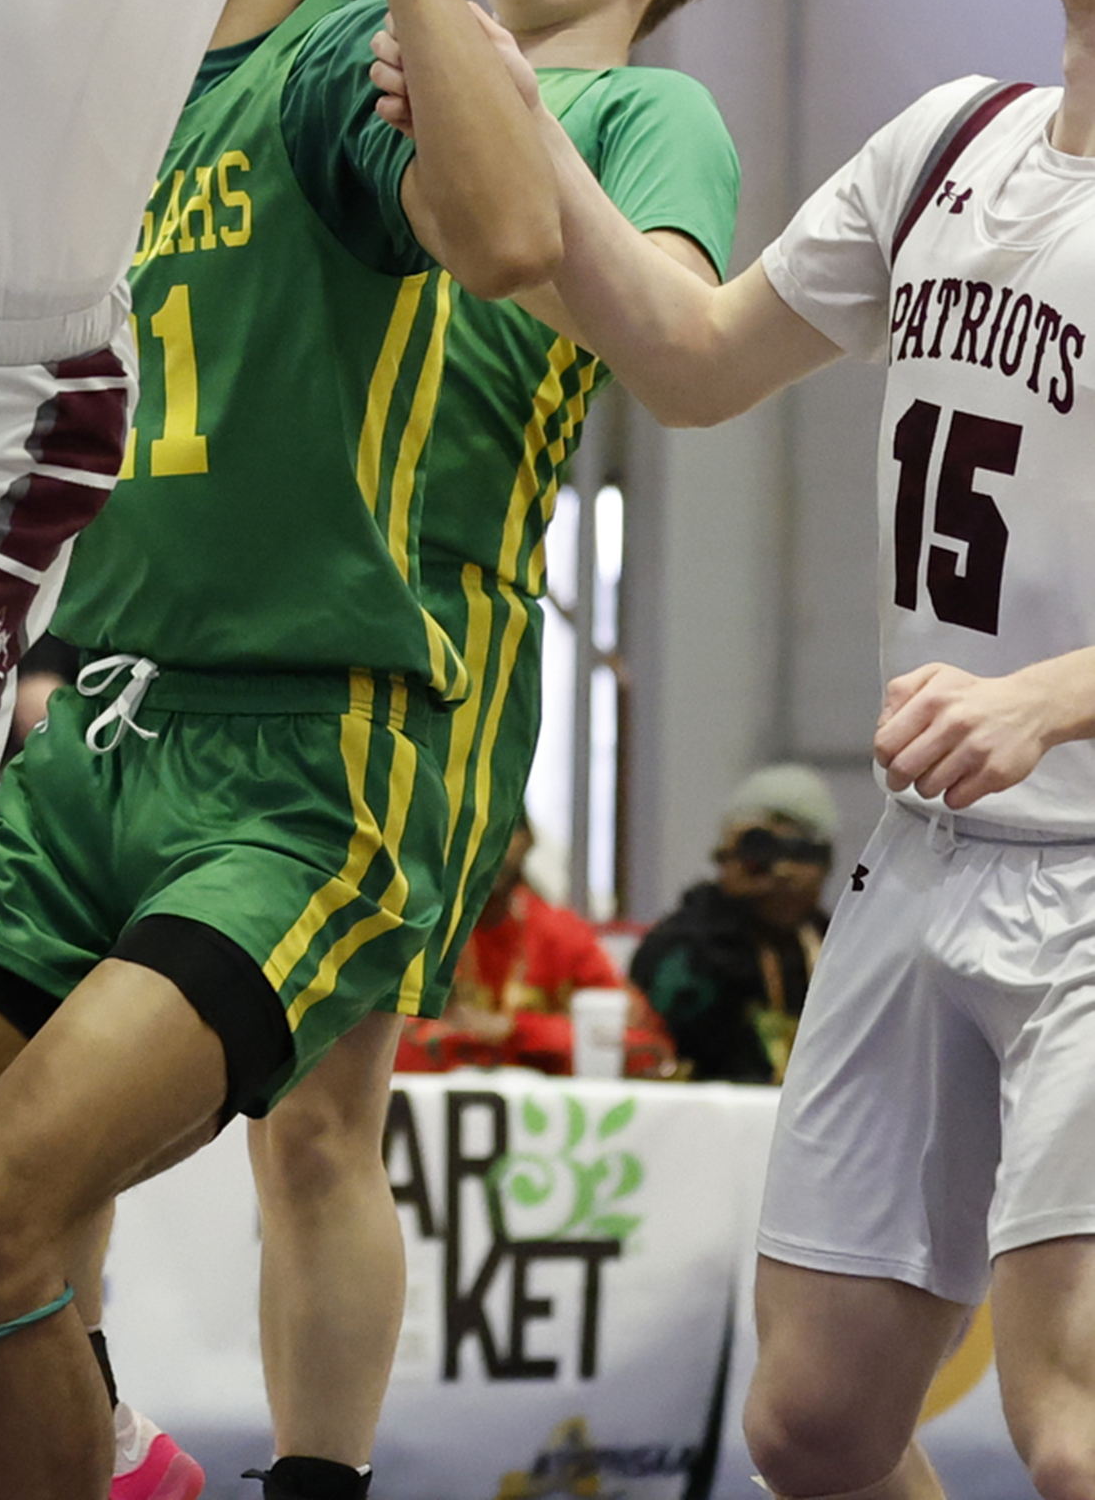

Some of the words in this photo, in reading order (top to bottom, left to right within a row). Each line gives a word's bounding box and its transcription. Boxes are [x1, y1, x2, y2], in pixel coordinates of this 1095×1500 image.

[889, 277, 1086, 414] PATRIOTS
[893, 398, 1024, 637] 15
[382, 1090, 507, 1238] AR
